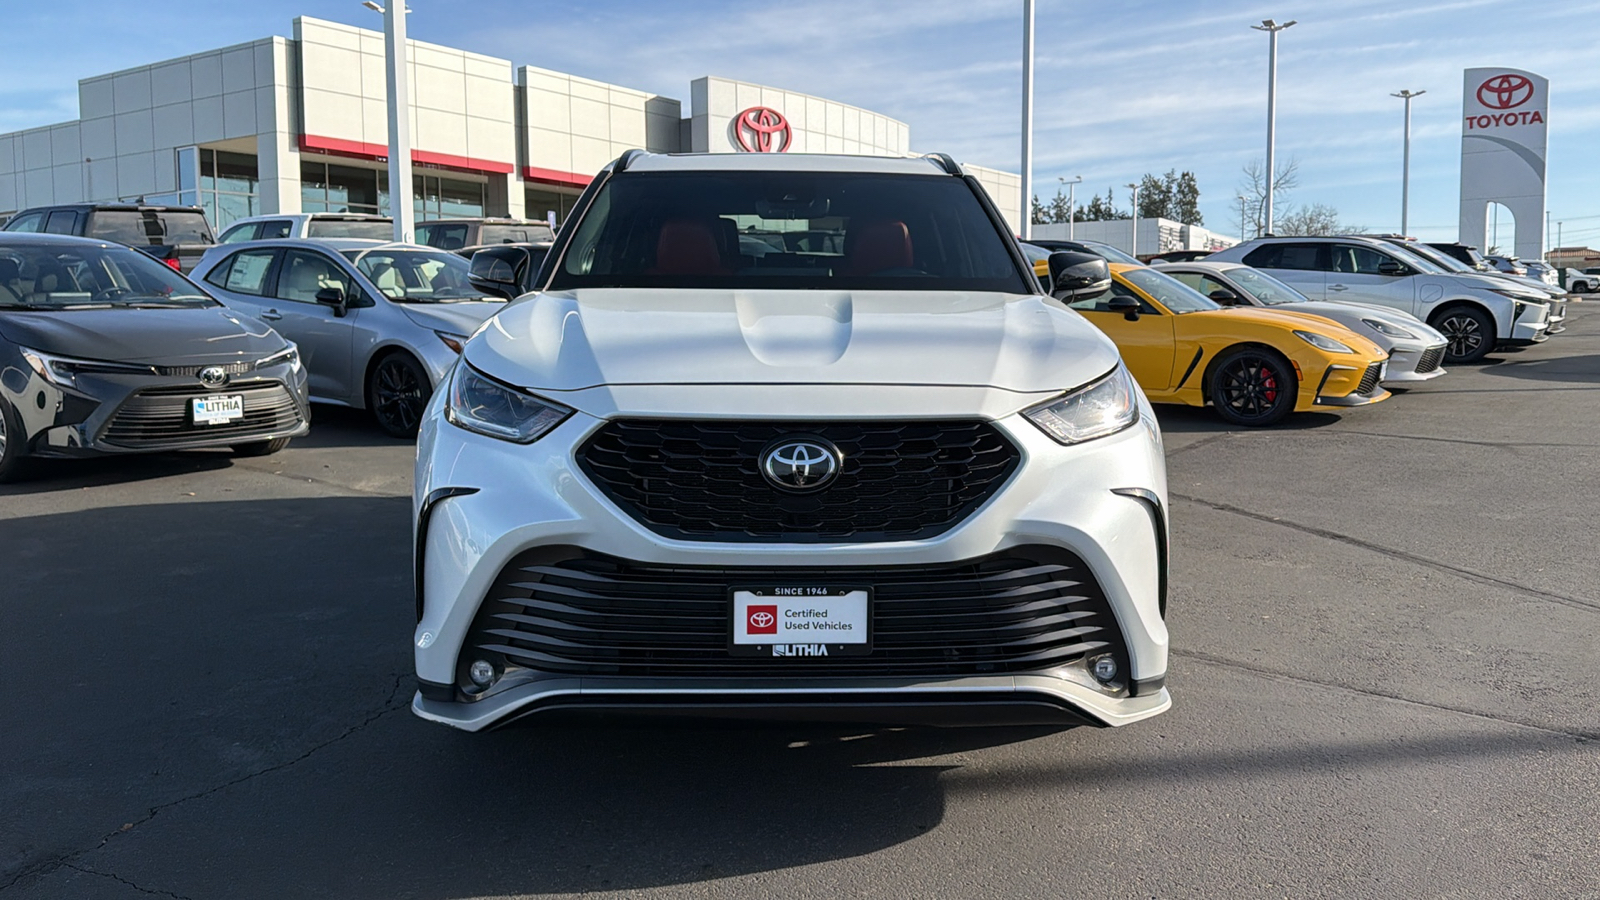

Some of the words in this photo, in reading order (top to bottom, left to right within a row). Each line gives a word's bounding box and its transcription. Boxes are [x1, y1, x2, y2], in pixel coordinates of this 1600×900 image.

[1466, 111, 1543, 129] TOYOTA
[206, 401, 240, 412] LITHIA
[784, 609, 828, 618] Certified
[784, 621, 810, 630] Used
[812, 621, 853, 630] Vehicles
[784, 644, 828, 656] LITHIA
